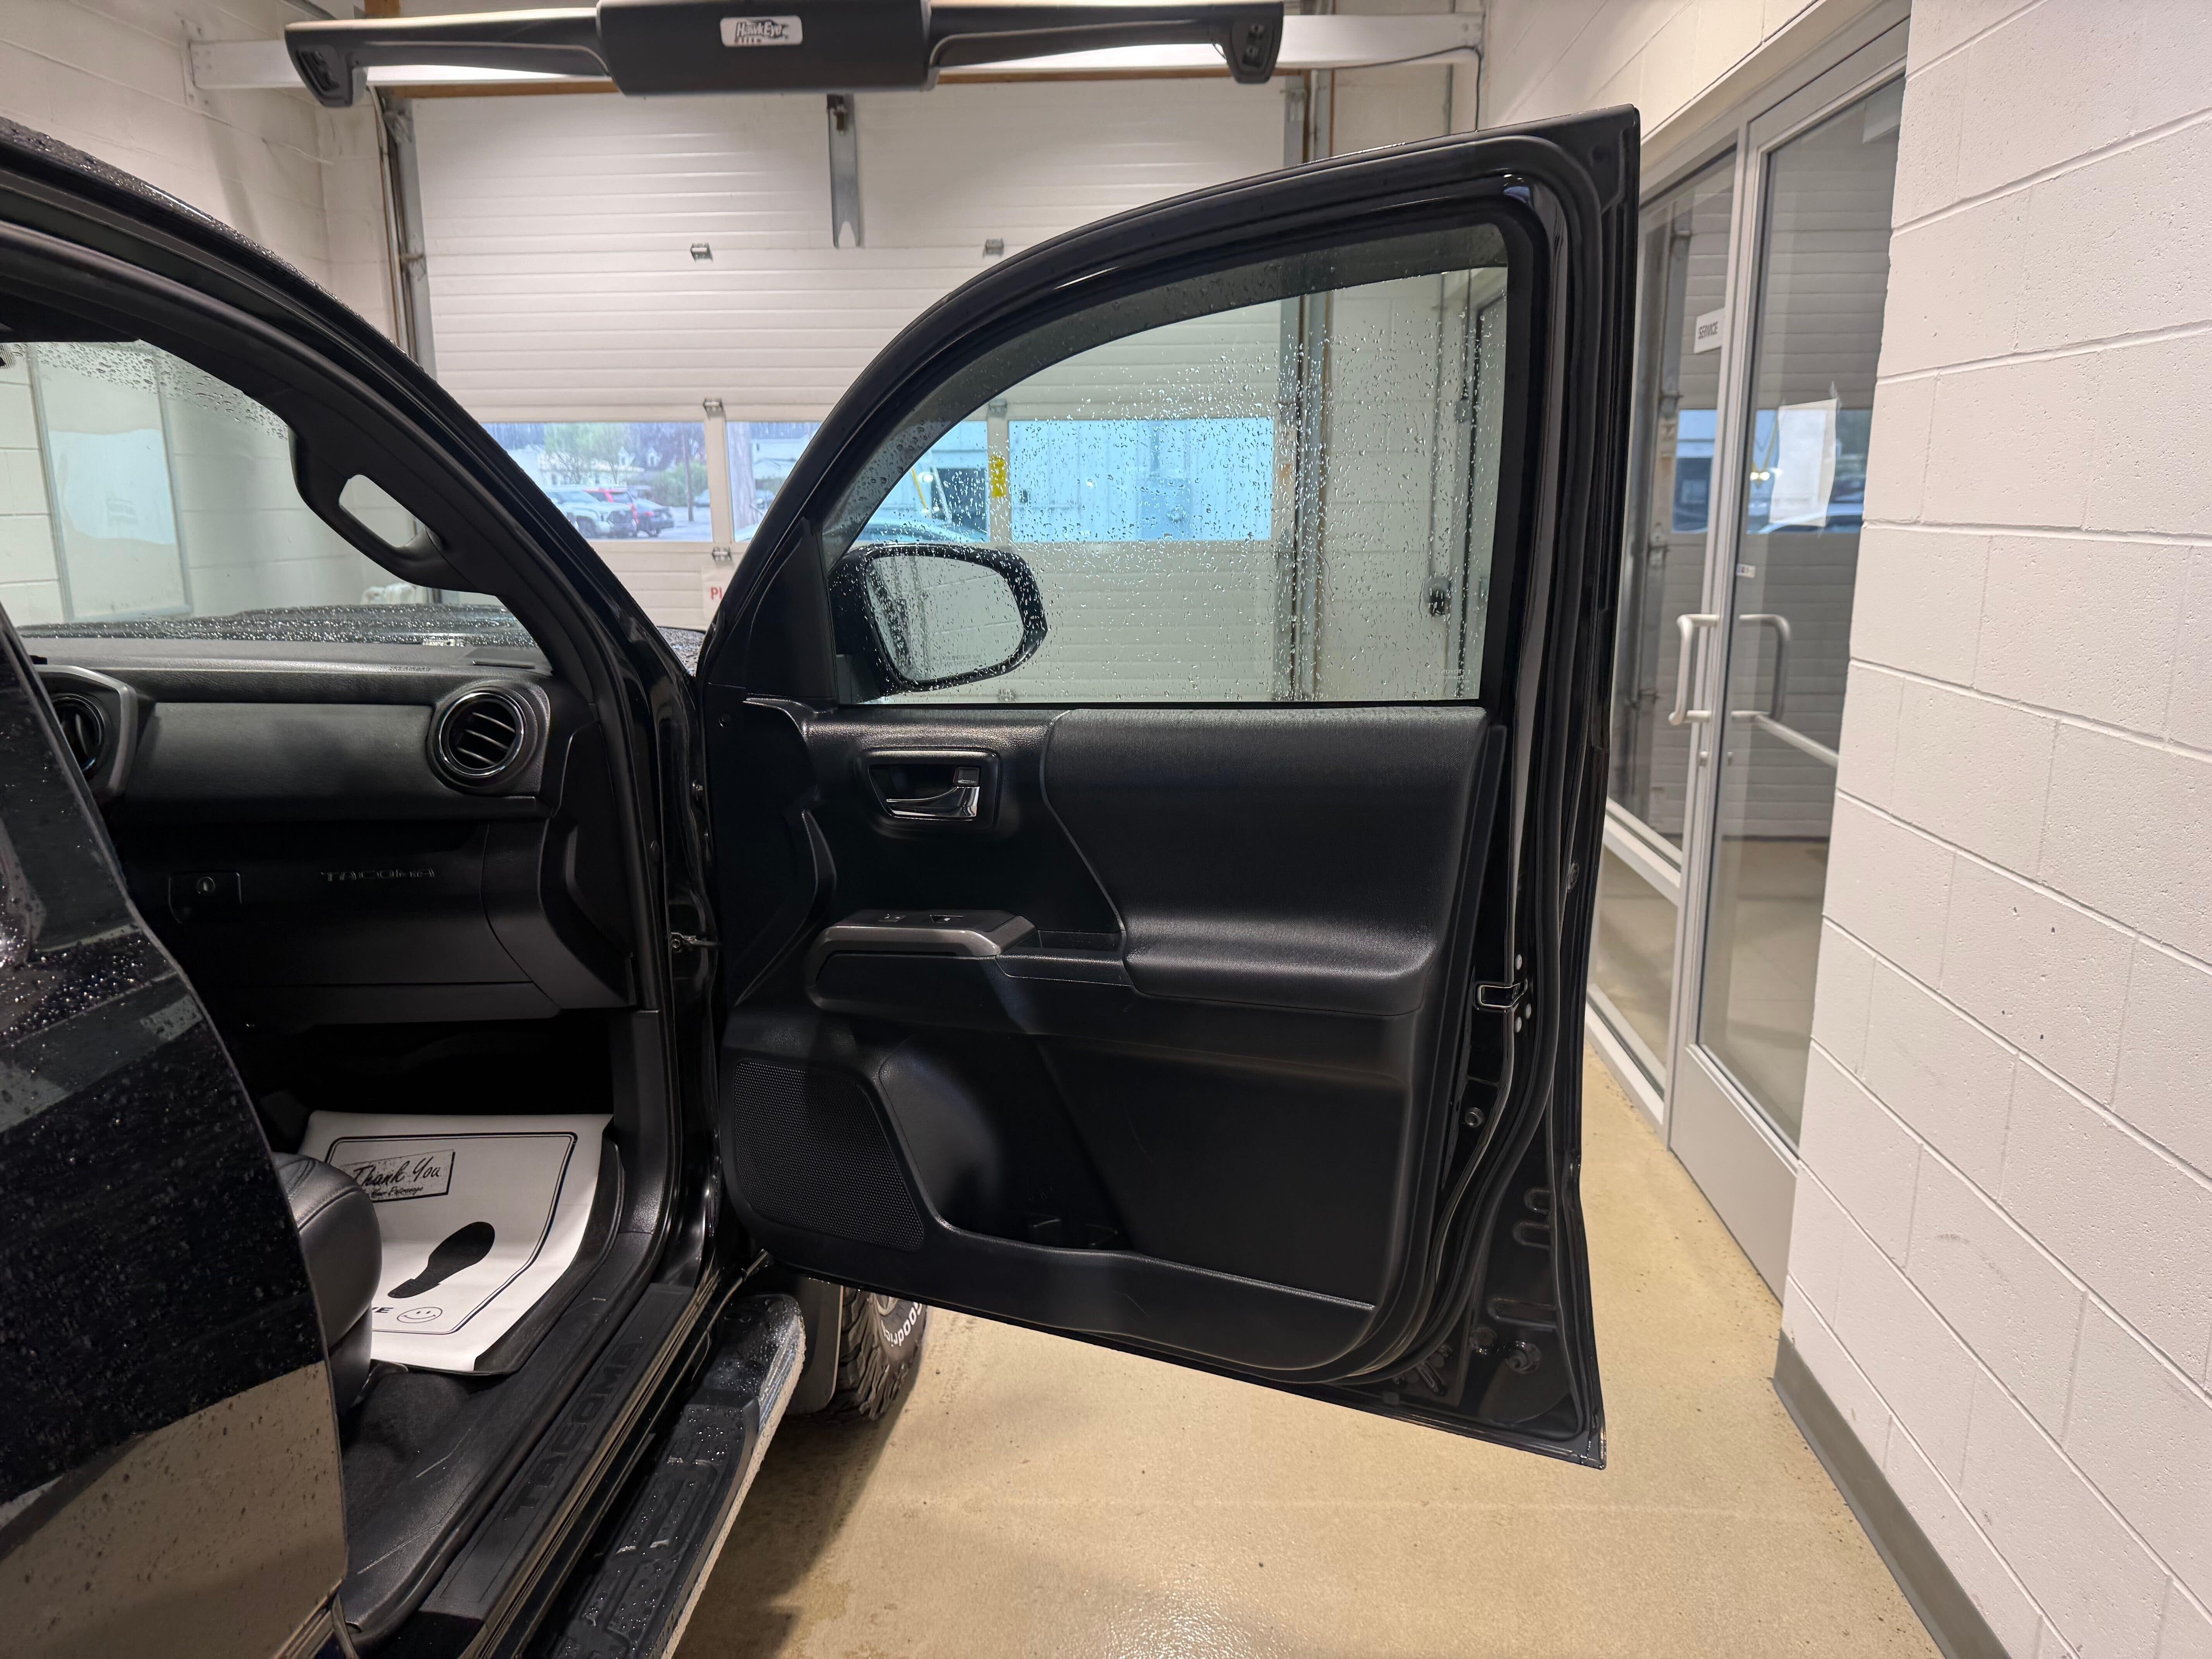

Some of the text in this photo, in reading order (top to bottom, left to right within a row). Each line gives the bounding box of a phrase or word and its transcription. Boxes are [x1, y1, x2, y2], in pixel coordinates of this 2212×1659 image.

[736, 21, 784, 38] HawkEye
[1698, 321, 1719, 340] SERVICE
[319, 867, 436, 882] TACOMA
[354, 1155, 441, 1187] Thank You
